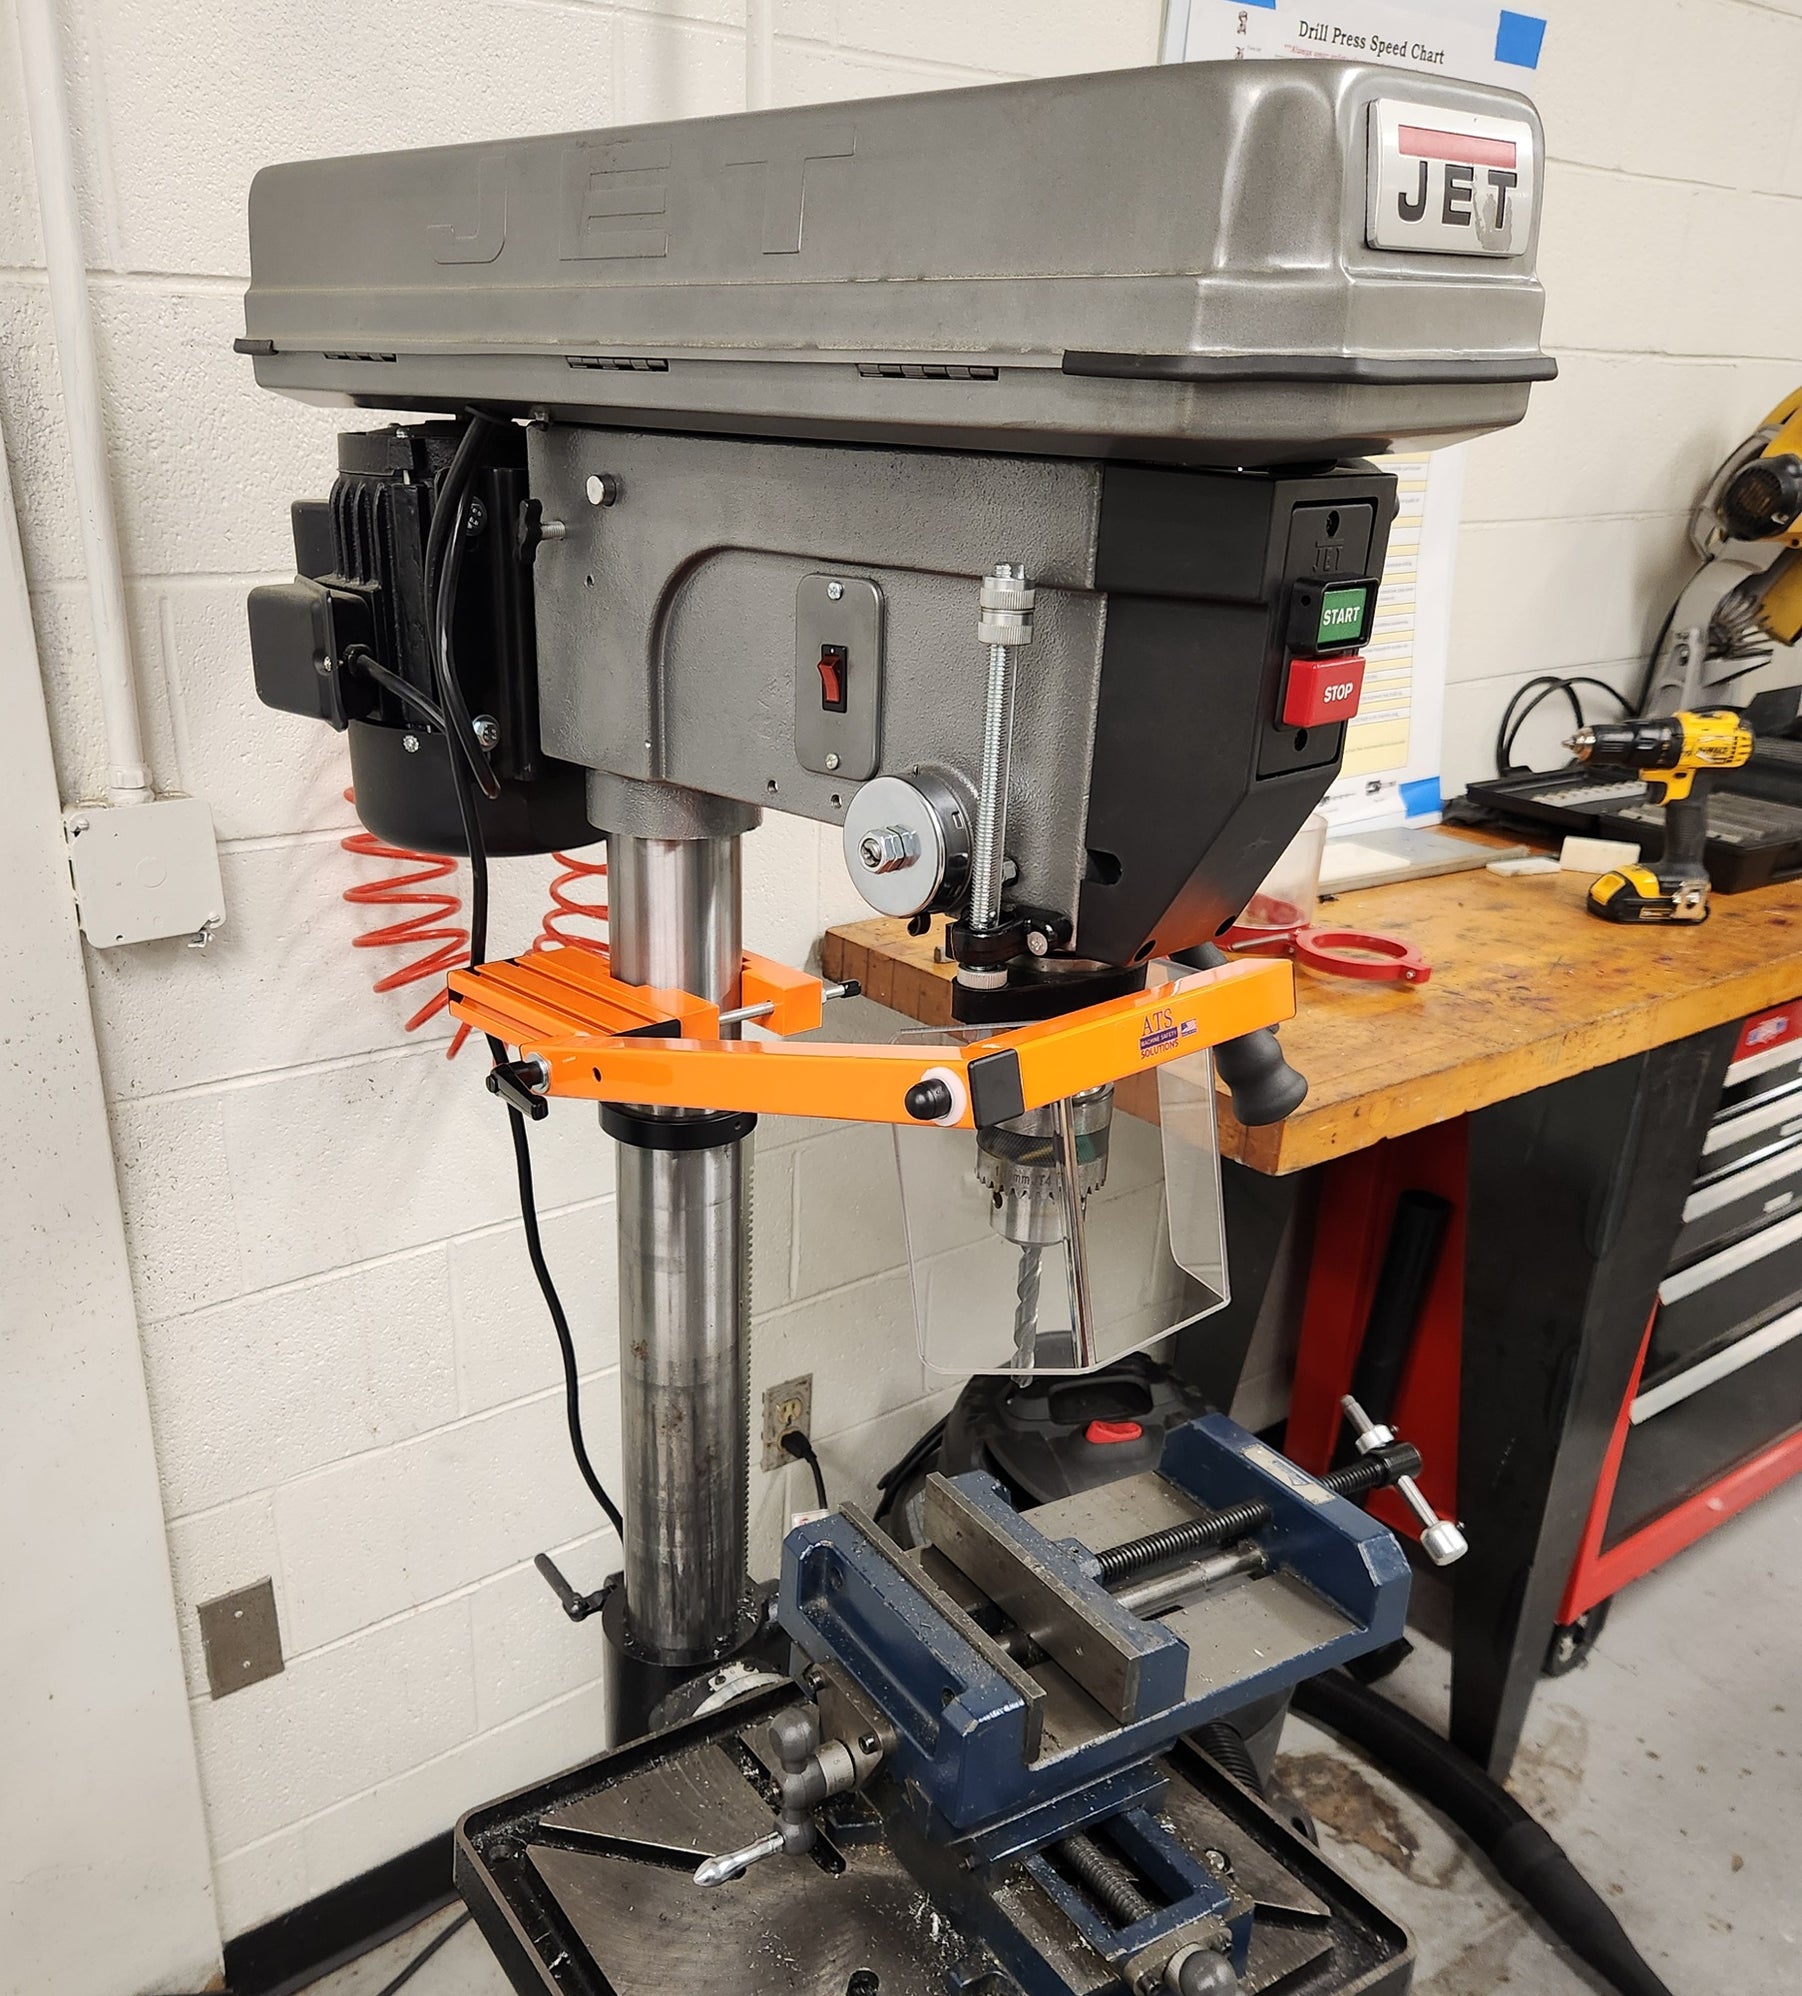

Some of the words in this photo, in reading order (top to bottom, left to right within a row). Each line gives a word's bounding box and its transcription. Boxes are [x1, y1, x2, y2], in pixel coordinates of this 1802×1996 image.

[1299, 20, 1329, 42] Drill
[1332, 27, 1366, 50] Press
[1370, 35, 1408, 58] Speed
[1411, 43, 1445, 65] Chart
[427, 125, 855, 265] JET
[1398, 161, 1517, 229] JET
[1323, 606, 1361, 626] START
[1323, 682, 1354, 704] STOP
[1142, 1008, 1173, 1037] ATS
[1141, 1039, 1179, 1059] SOLUTIONS
